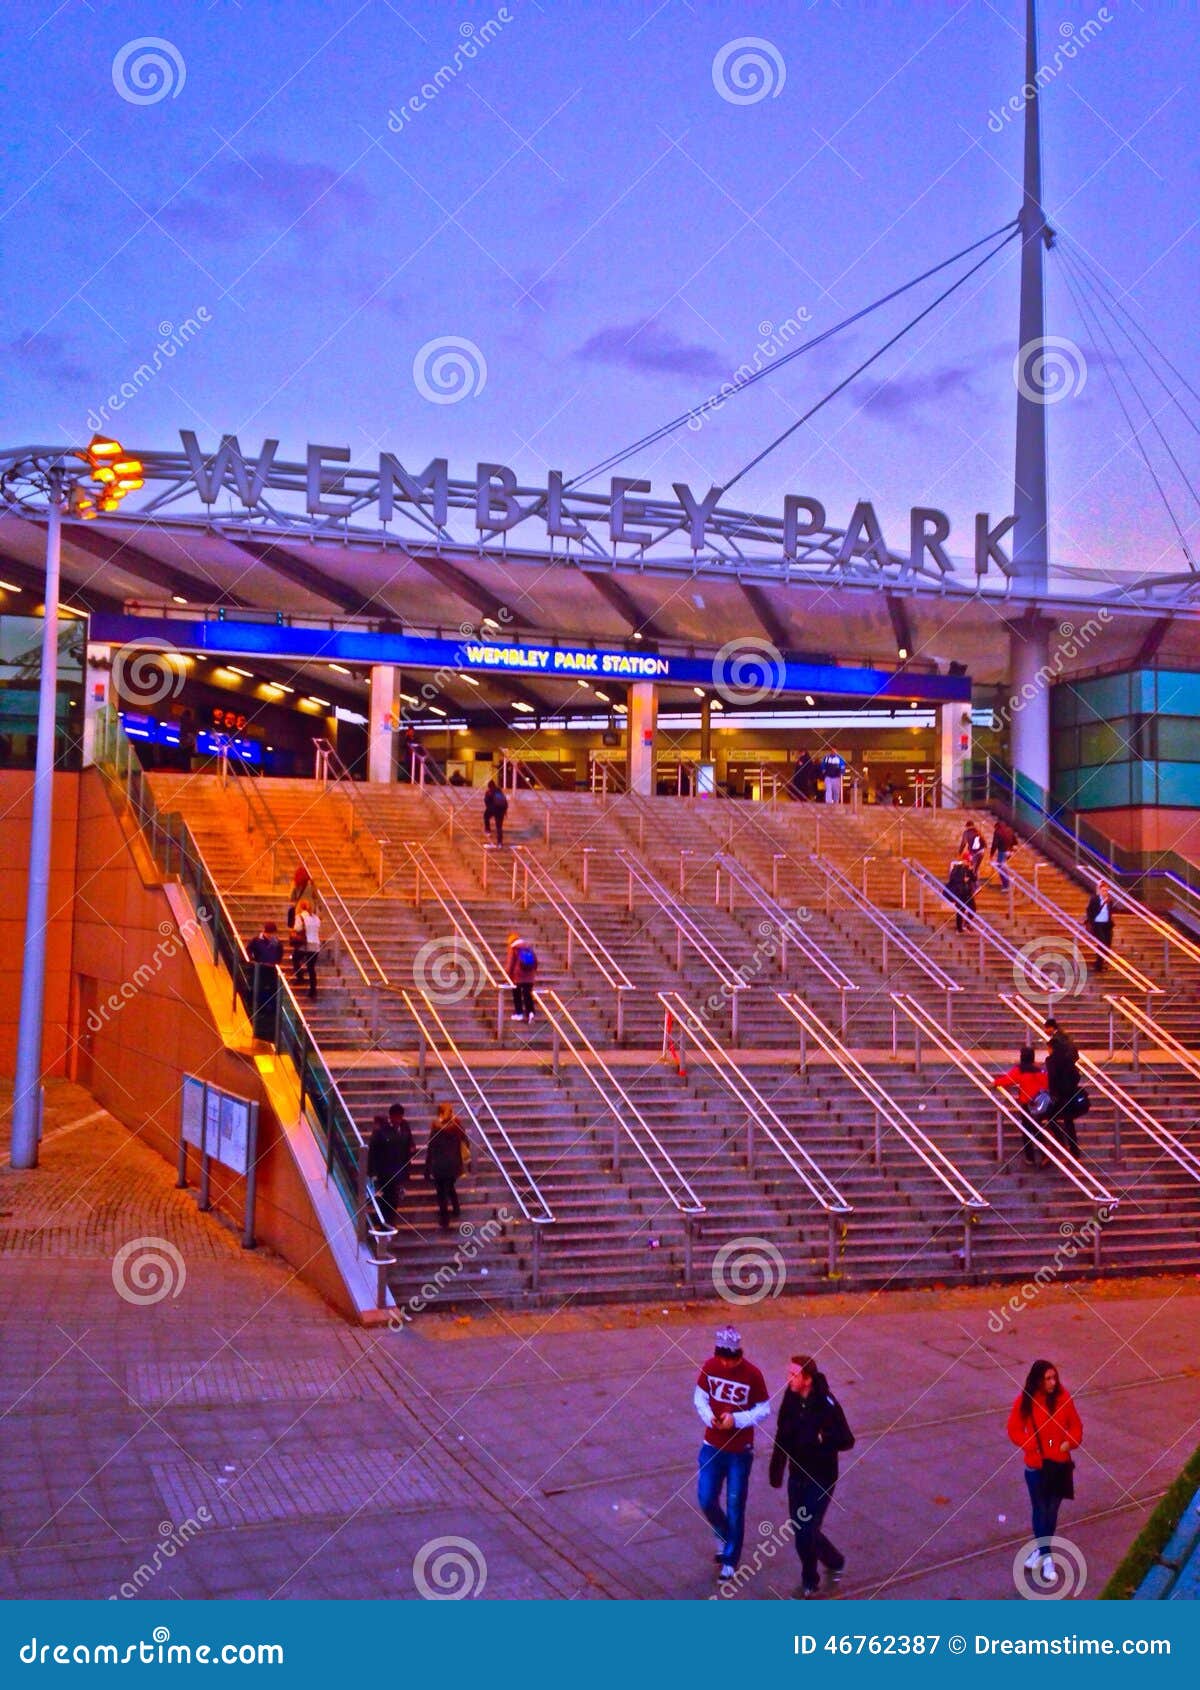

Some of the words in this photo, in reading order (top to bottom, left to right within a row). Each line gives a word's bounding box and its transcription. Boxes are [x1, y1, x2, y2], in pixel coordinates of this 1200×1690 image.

[179, 429, 723, 549] WEMBLEY
[784, 494, 1019, 577] PARK
[467, 646, 550, 667] WEMBLEY
[554, 652, 597, 671] PARK
[602, 656, 669, 675] STATION
[709, 1379, 747, 1402] YES
